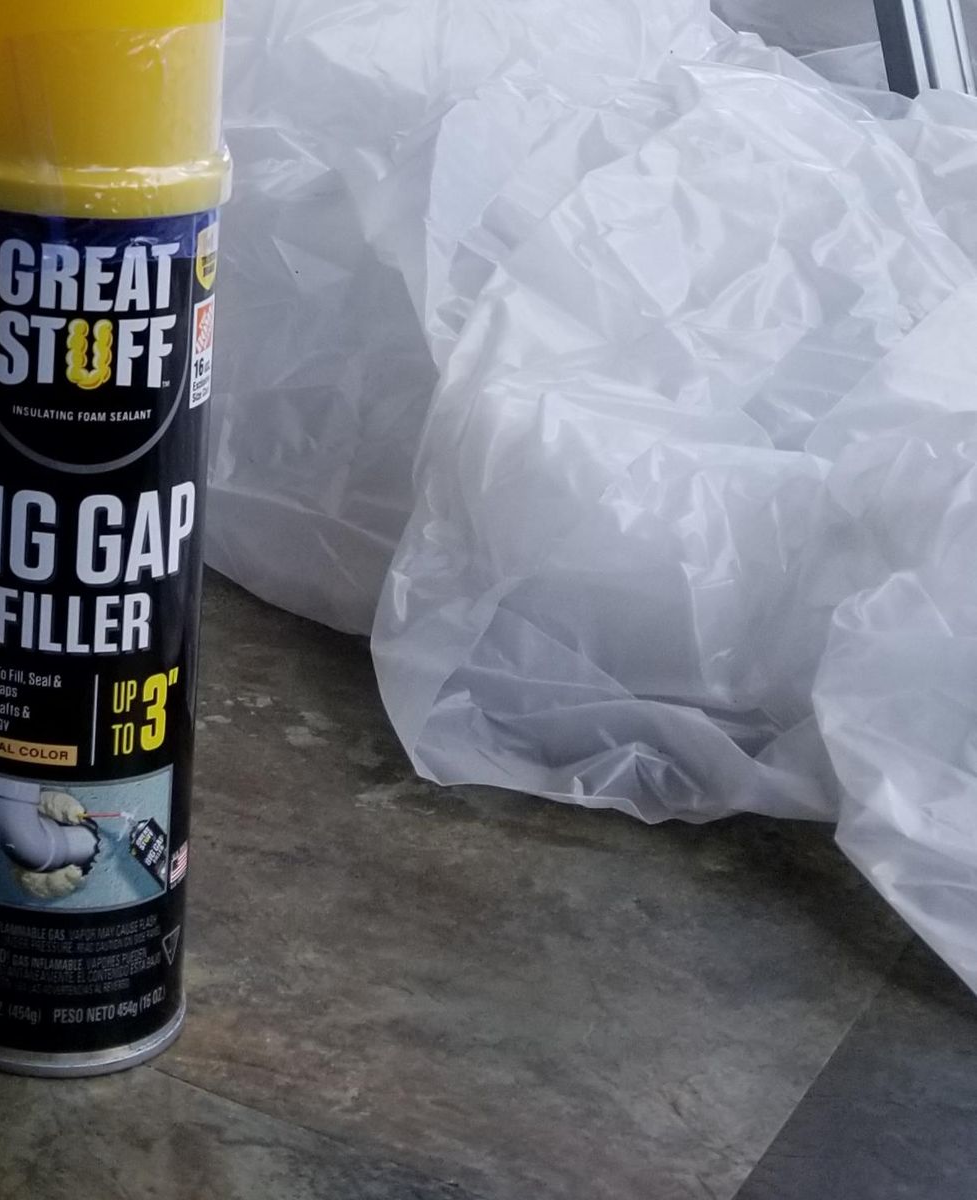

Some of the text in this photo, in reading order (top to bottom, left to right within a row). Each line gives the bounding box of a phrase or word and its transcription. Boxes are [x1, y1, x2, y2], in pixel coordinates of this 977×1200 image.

[194, 358, 204, 378] 16
[12, 404, 151, 421] INSULATING FOAM SEALANT
[76, 480, 196, 585] GAP
[28, 672, 52, 687] Seal
[53, 675, 62, 688] &
[113, 680, 137, 714] UP
[22, 705, 31, 719] &
[111, 722, 134, 756] TO
[19, 746, 68, 761] COLOR
[53, 1008, 84, 1024] PESO
[86, 1004, 115, 1023] NETO
[116, 1000, 138, 1018] 454g
